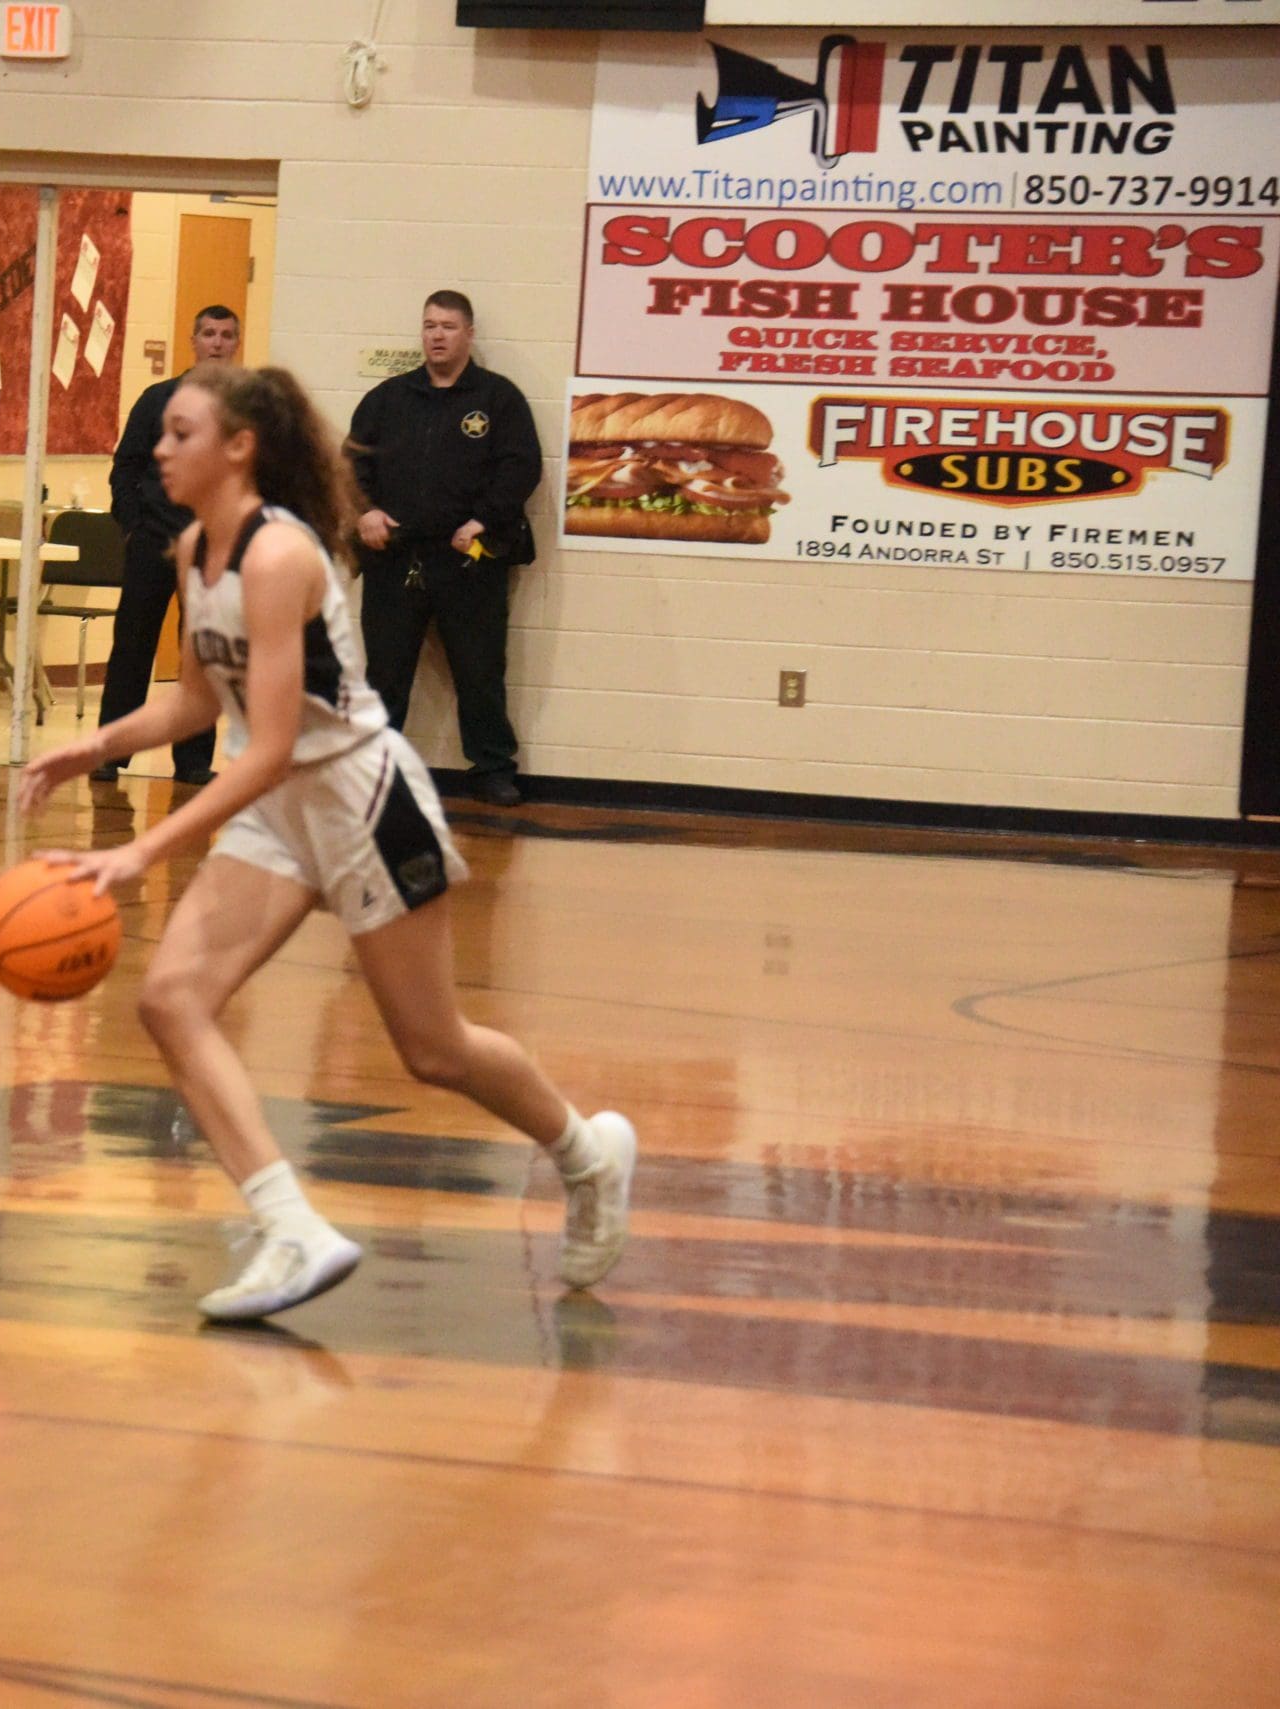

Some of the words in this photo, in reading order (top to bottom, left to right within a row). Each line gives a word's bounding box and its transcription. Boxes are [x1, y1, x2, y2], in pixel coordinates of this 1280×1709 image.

[6, 6, 61, 51] EXIT
[899, 45, 1176, 115] TITAN
[900, 121, 1175, 155] PAINTING
[598, 170, 1003, 209] www.Titanpainting.com
[1024, 174, 1279, 206] 850-737-9914
[602, 214, 1265, 279] SCOOTER'S
[647, 277, 860, 320] FISH
[881, 283, 1205, 328] HOUSE
[727, 326, 878, 352] QUICK
[890, 331, 1108, 359] SERVICE,
[719, 351, 876, 377] FRESH
[888, 354, 1115, 383] SEAFOOD
[819, 404, 1218, 480] FIREHOUSE
[940, 455, 1084, 493] SUBS
[831, 515, 978, 539] FOUNDED
[994, 525, 1031, 541] BY
[1048, 524, 1195, 547] FIREMEN
[796, 540, 852, 559] 1894
[858, 543, 969, 564] ANDORRA
[976, 549, 1005, 565] ST
[1051, 551, 1227, 575] 850.515.0957
